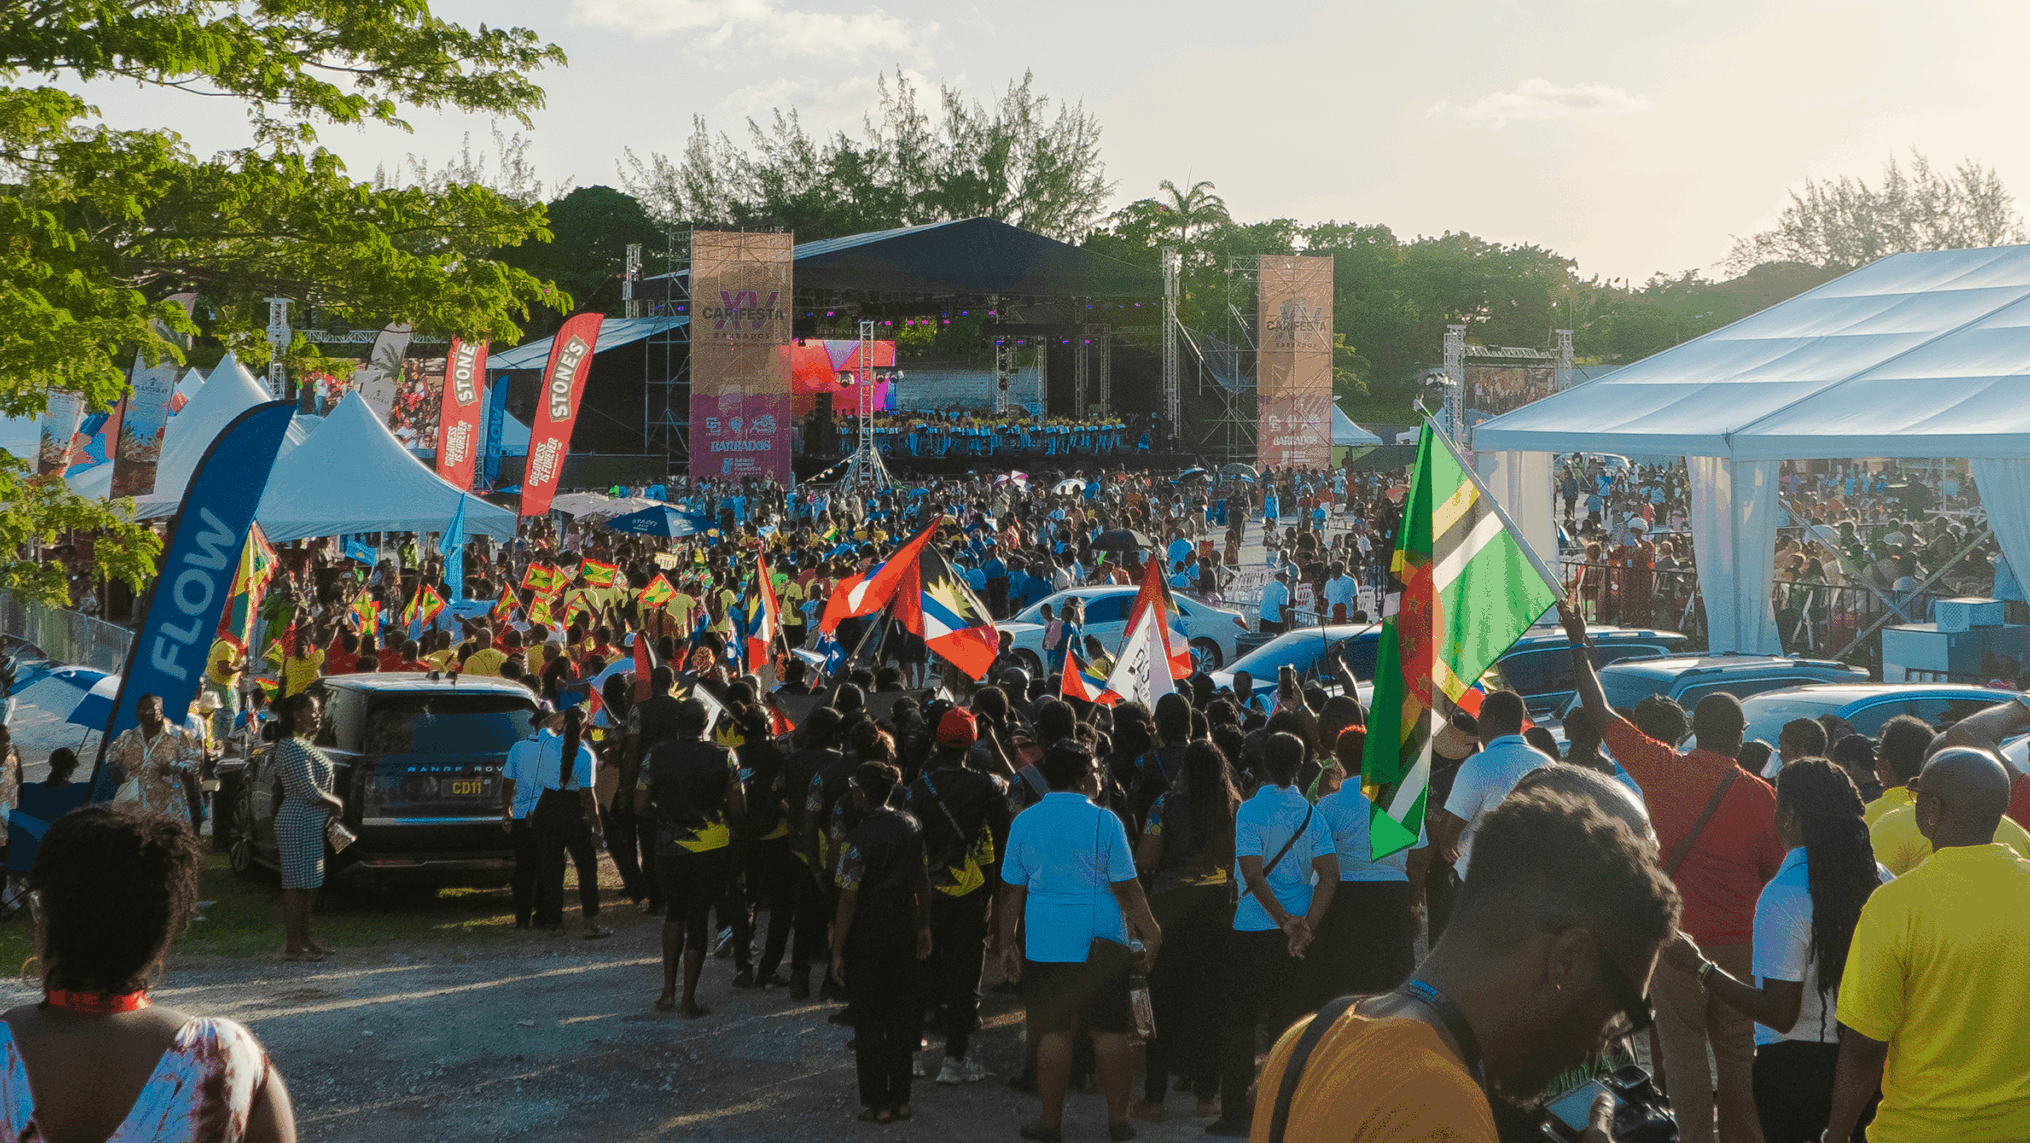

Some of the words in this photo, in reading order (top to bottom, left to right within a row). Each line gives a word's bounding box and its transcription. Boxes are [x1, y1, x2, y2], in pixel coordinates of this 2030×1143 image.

[702, 307, 784, 320] CARIFESTA
[455, 343, 476, 402] STONE
[551, 341, 584, 418] STONE'S
[444, 425, 457, 467] GREATNESS
[489, 405, 503, 458] FLOW
[711, 441, 771, 452] BARBADOS
[528, 441, 546, 487] GREATNESS
[541, 436, 559, 474] FOREVER
[151, 507, 236, 682] FLOW
[452, 781, 482, 795] CD11
